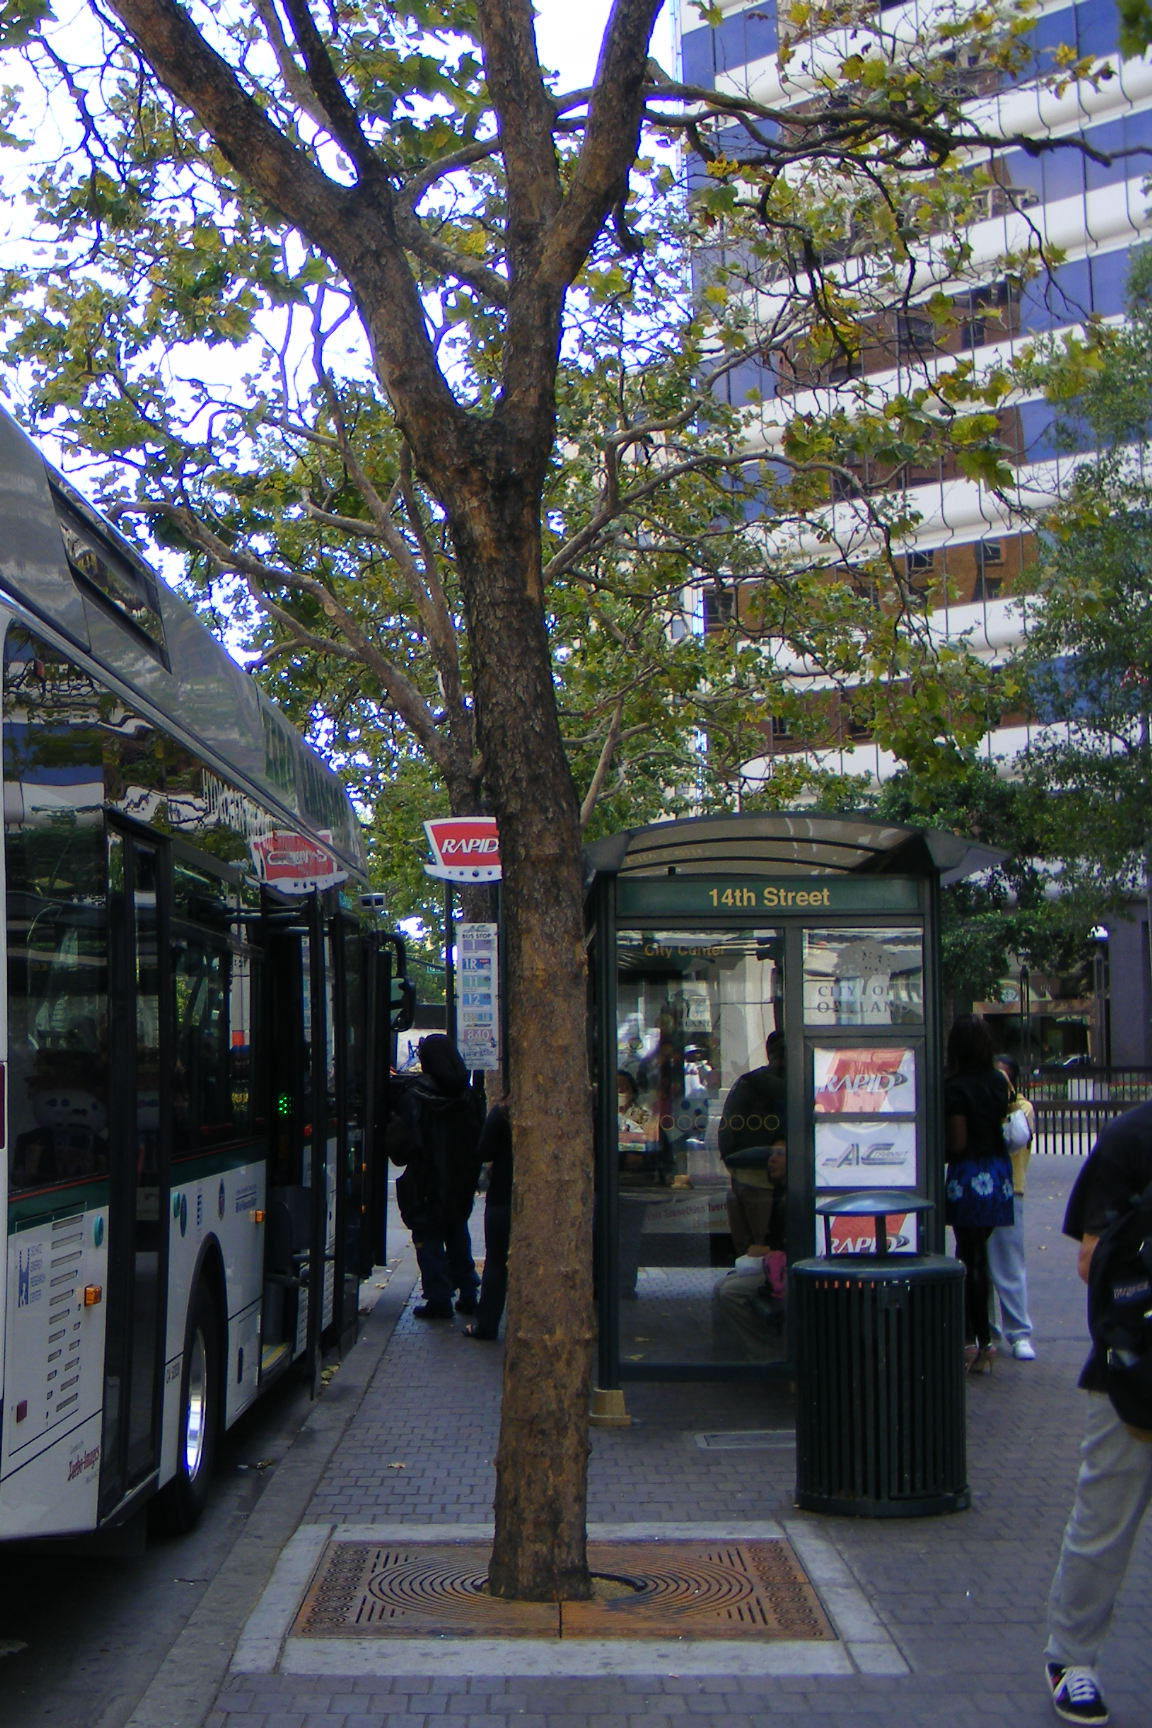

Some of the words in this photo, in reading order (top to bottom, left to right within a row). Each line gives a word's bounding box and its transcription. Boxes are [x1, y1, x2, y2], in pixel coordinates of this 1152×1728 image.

[441, 838, 500, 854] RAPID
[709, 887, 757, 907] 14th
[763, 886, 831, 907] Street
[464, 958, 478, 970] 1R
[817, 1000, 913, 1014] OLAN
[819, 1073, 896, 1094] RAPID
